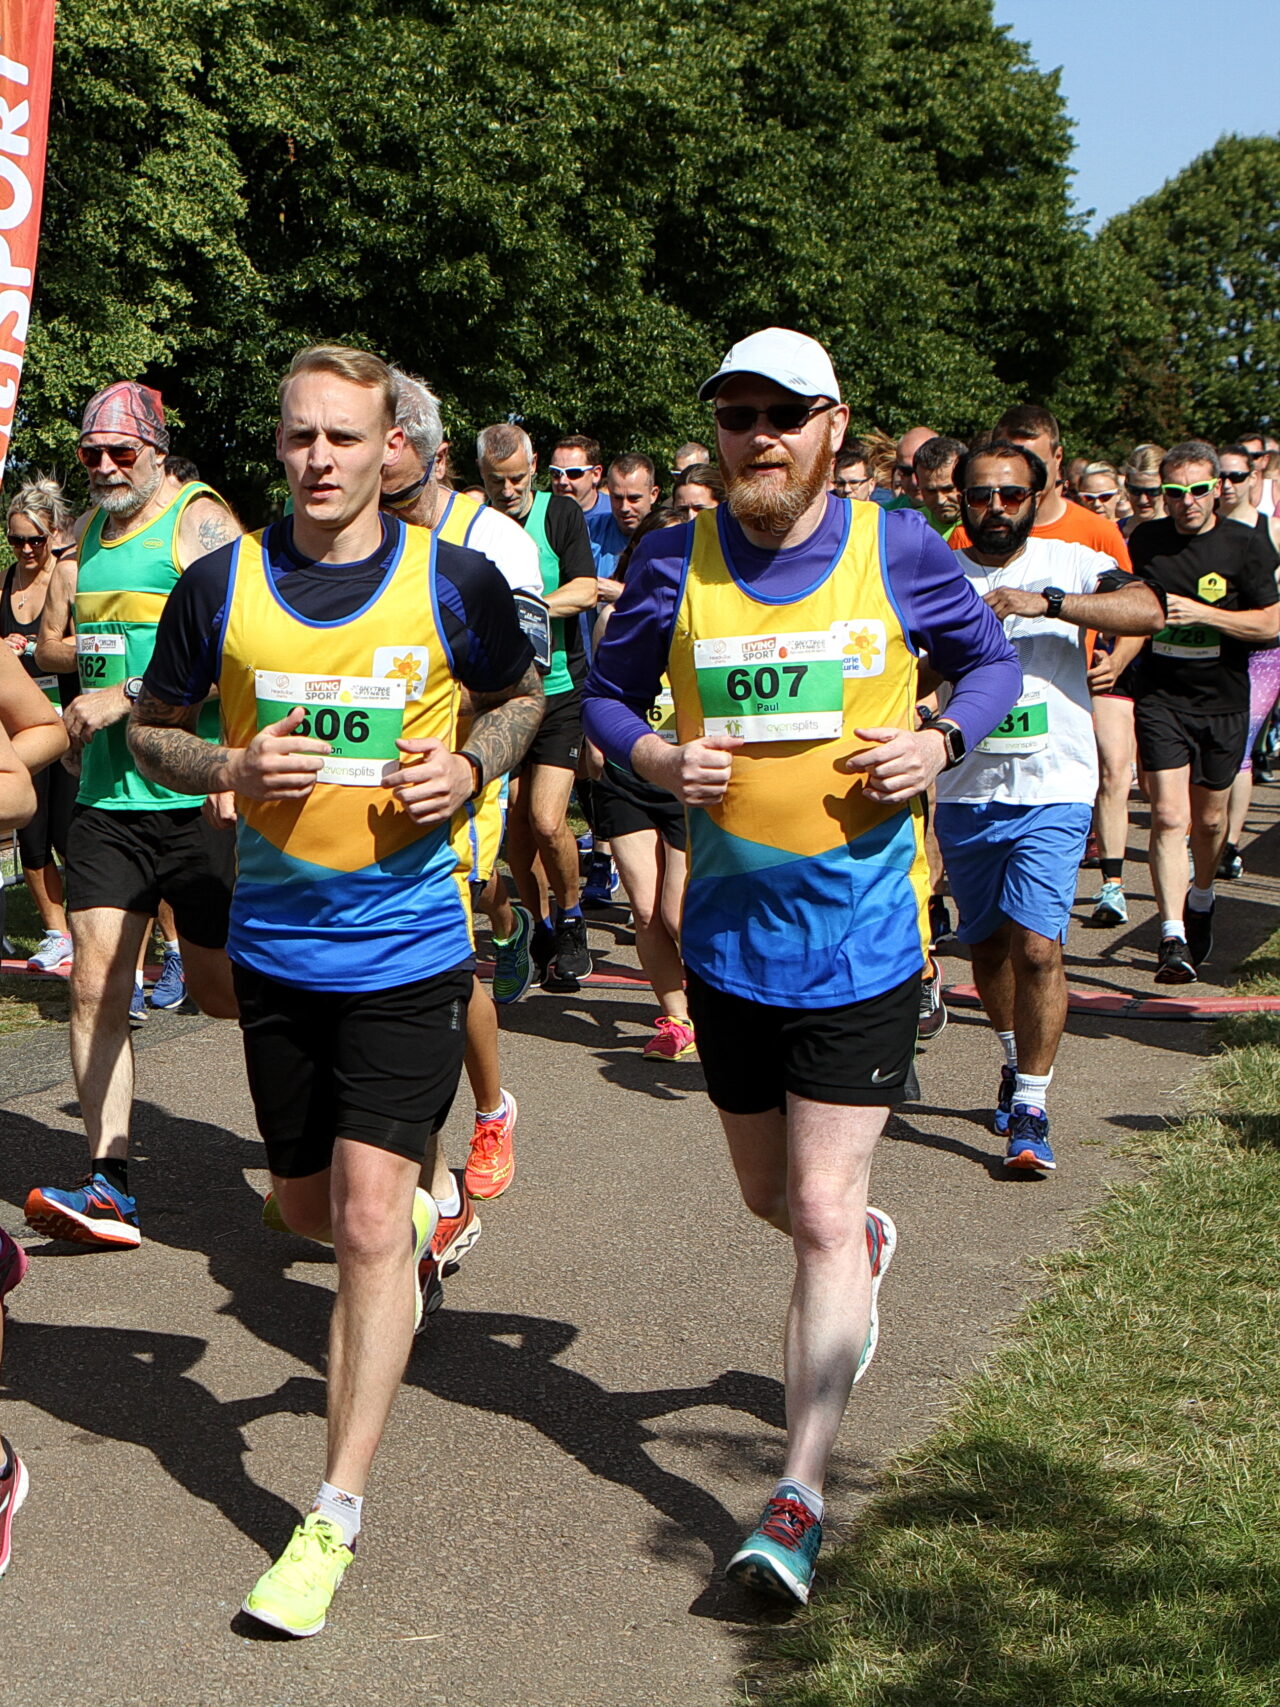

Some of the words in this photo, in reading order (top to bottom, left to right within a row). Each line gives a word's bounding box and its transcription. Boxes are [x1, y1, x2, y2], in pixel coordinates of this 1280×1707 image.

[742, 640, 776, 653] LIVING
[743, 650, 775, 661] SPORT
[305, 681, 340, 692] LIVING
[726, 664, 808, 701] 607
[305, 691, 338, 701] SPORT
[756, 702, 779, 712] Paul
[287, 705, 370, 743] 606
[998, 711, 1030, 733] 31
[323, 766, 375, 778] evensplits
